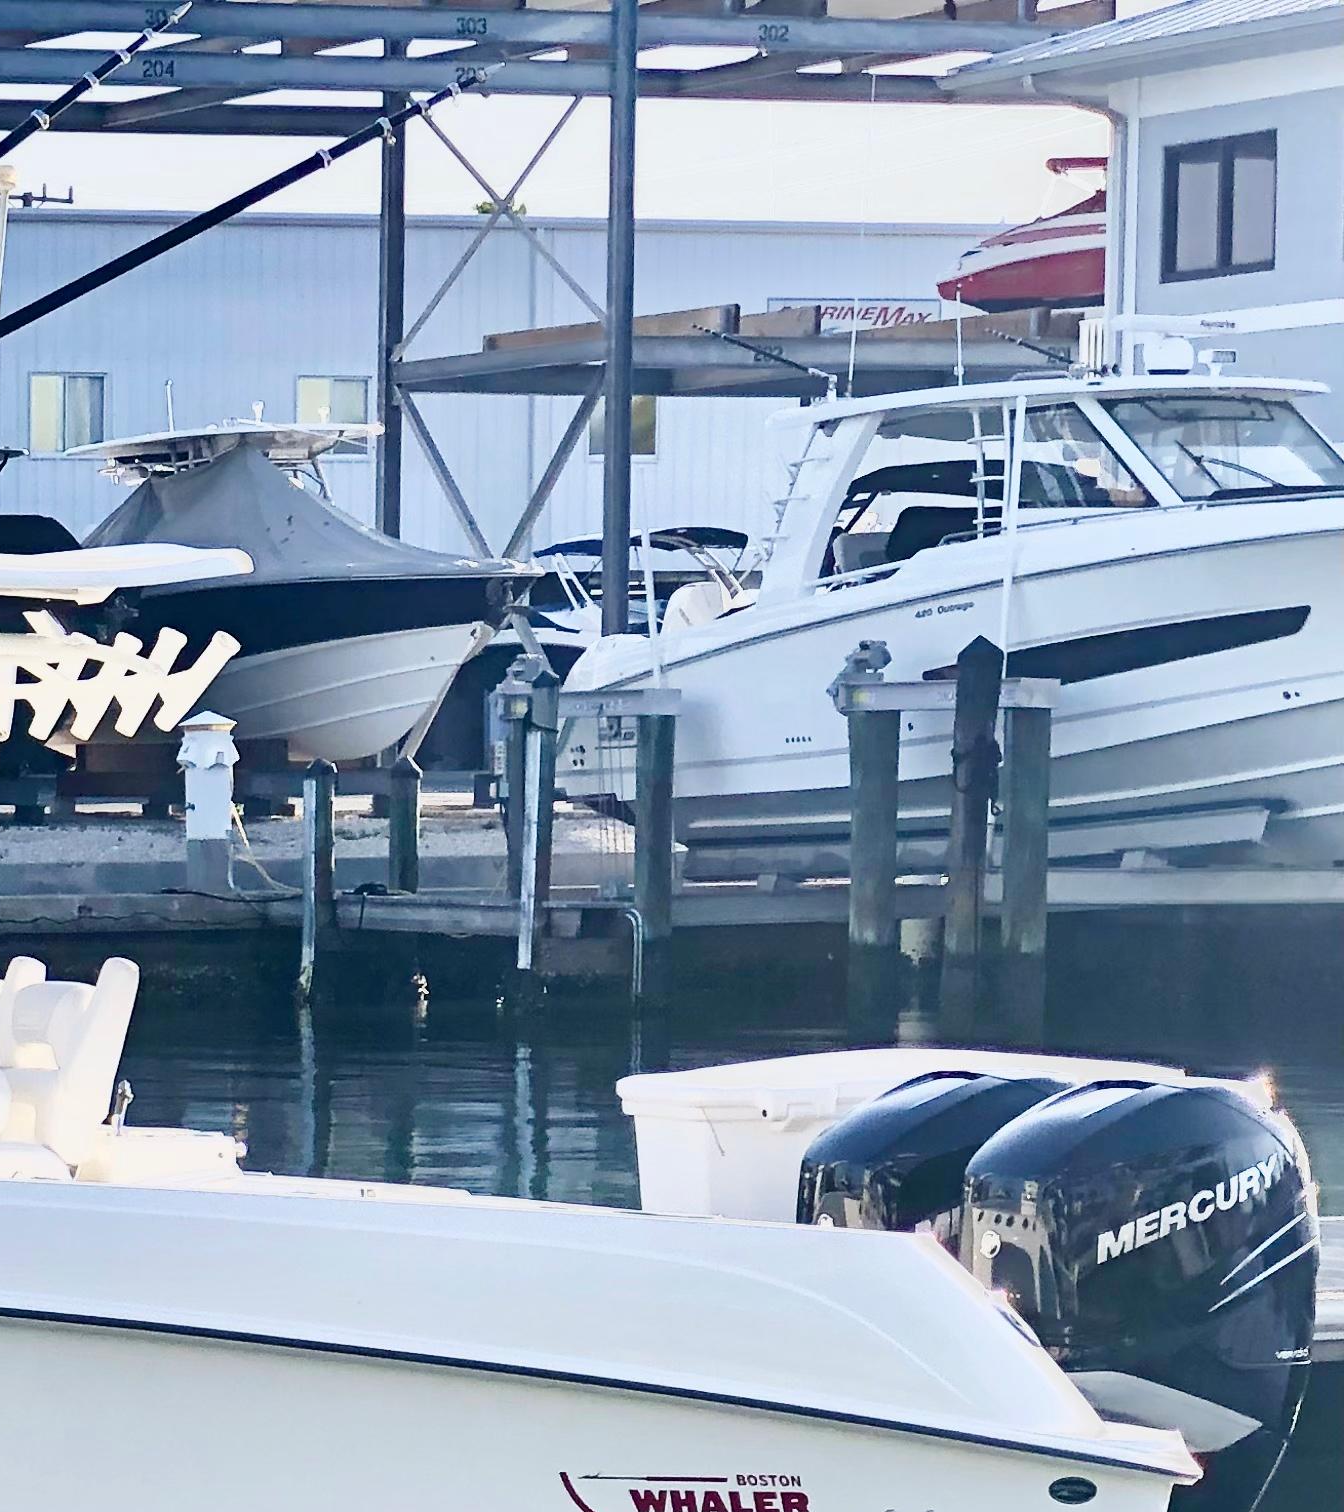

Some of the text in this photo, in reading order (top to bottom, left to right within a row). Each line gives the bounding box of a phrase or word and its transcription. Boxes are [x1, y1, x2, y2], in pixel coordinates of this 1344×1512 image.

[456, 17, 487, 35] 303
[758, 23, 789, 42] 302
[142, 60, 175, 78] 204
[1097, 1152, 1278, 1264] MERCURY
[736, 1473, 802, 1487] BOSTON
